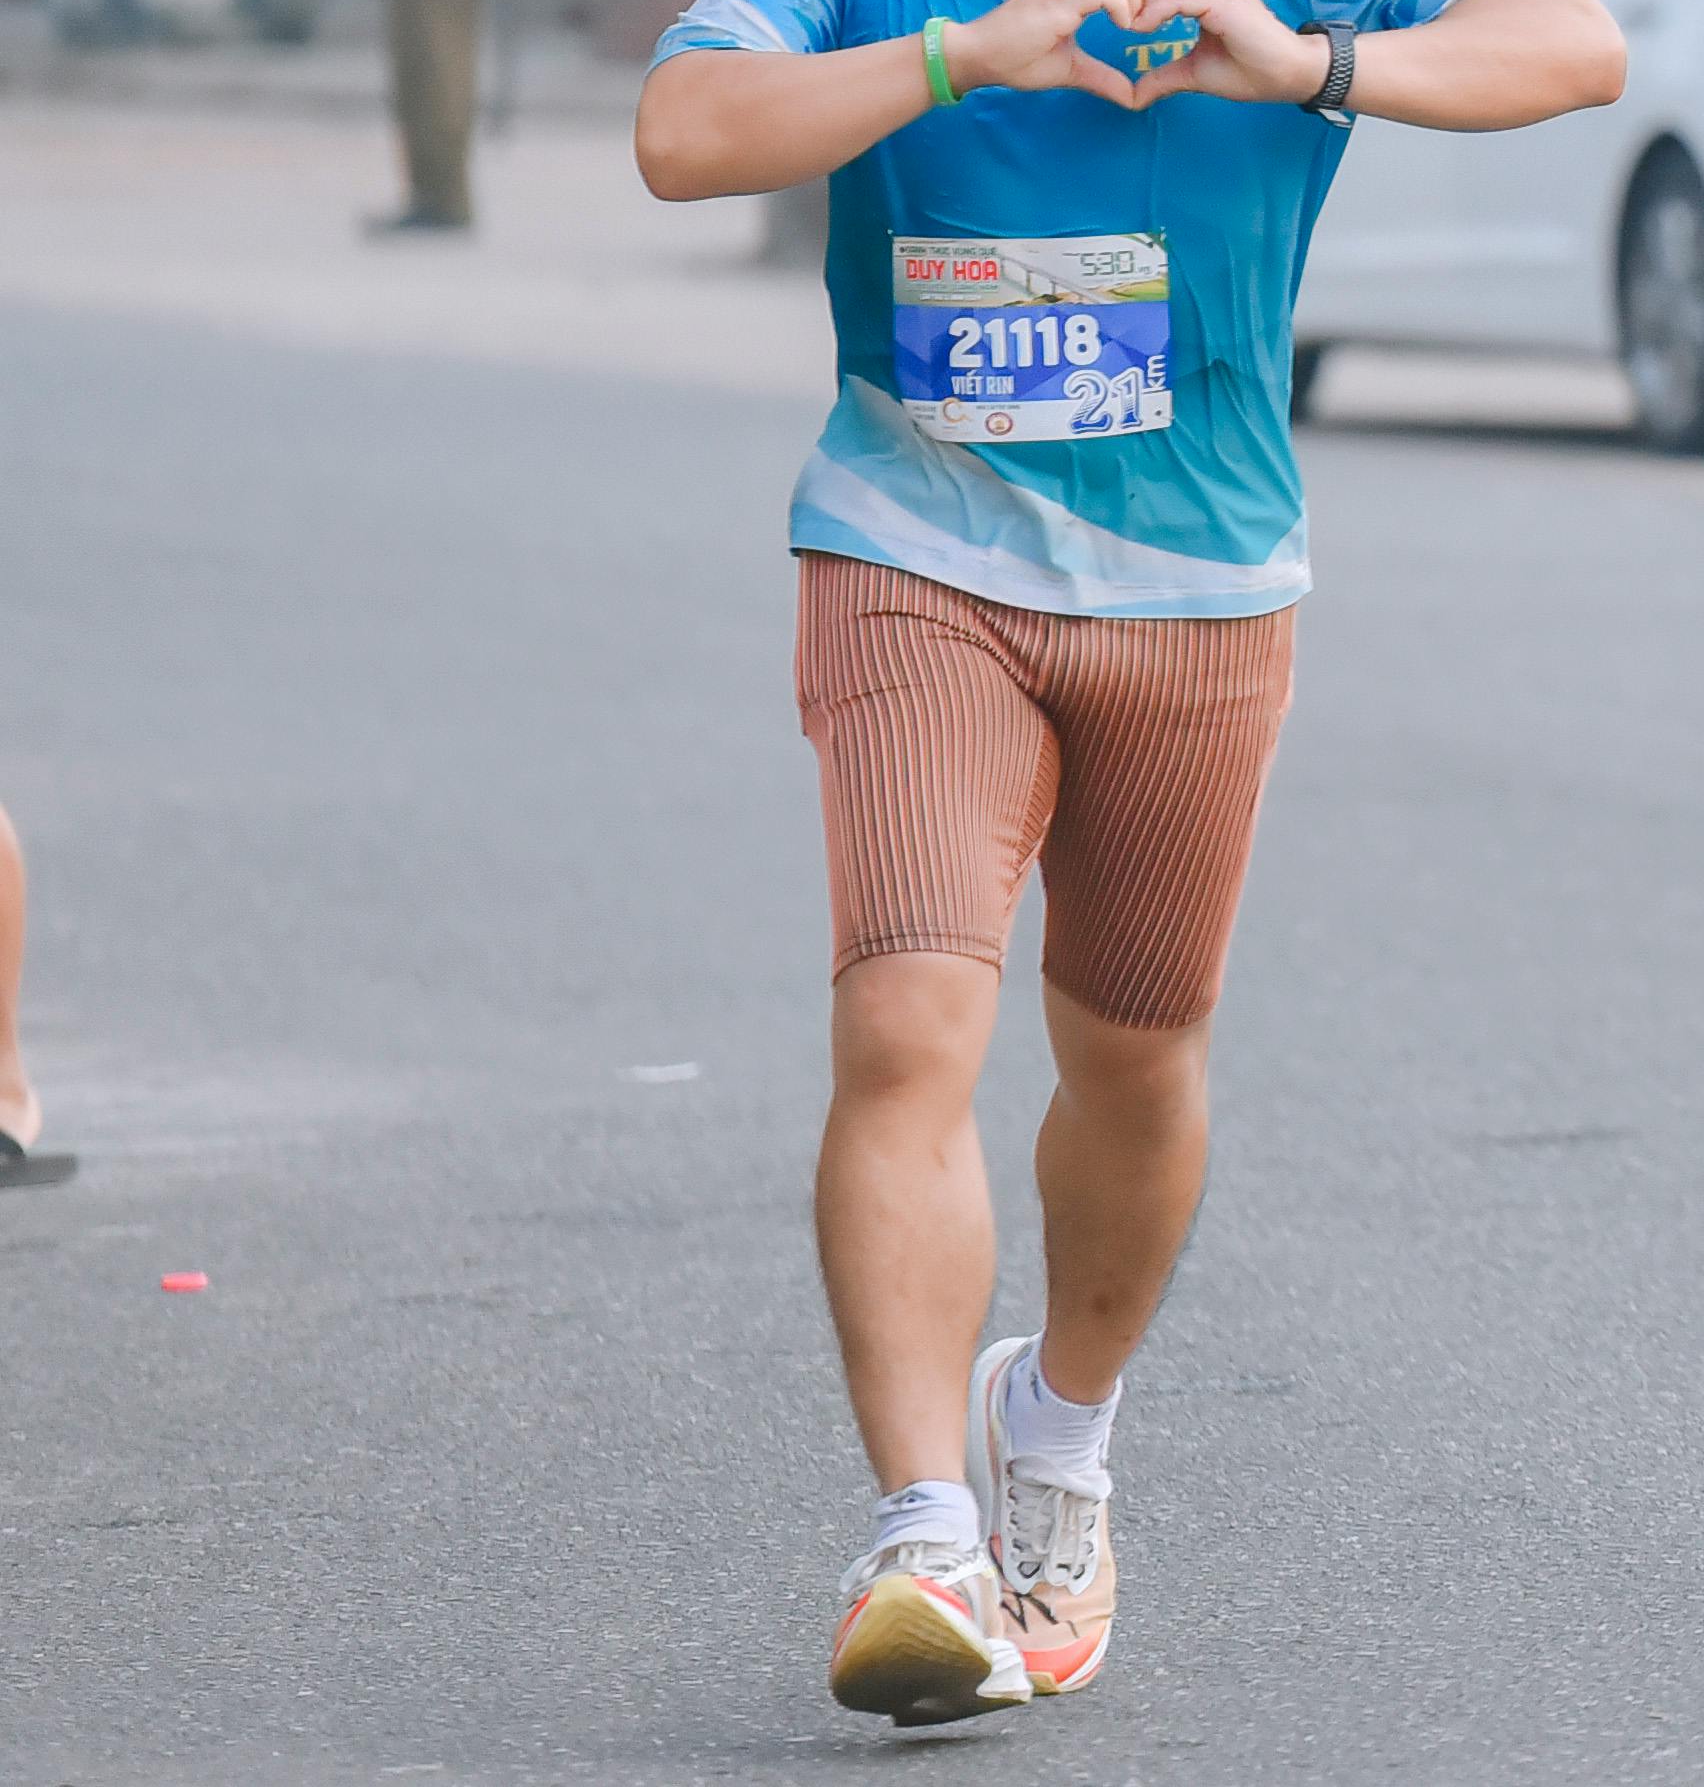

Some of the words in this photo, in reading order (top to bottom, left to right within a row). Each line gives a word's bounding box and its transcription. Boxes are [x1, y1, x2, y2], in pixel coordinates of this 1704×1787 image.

[906, 259, 945, 282] DUY
[949, 314, 1102, 368] 21118
[1064, 369, 1145, 434] 21
